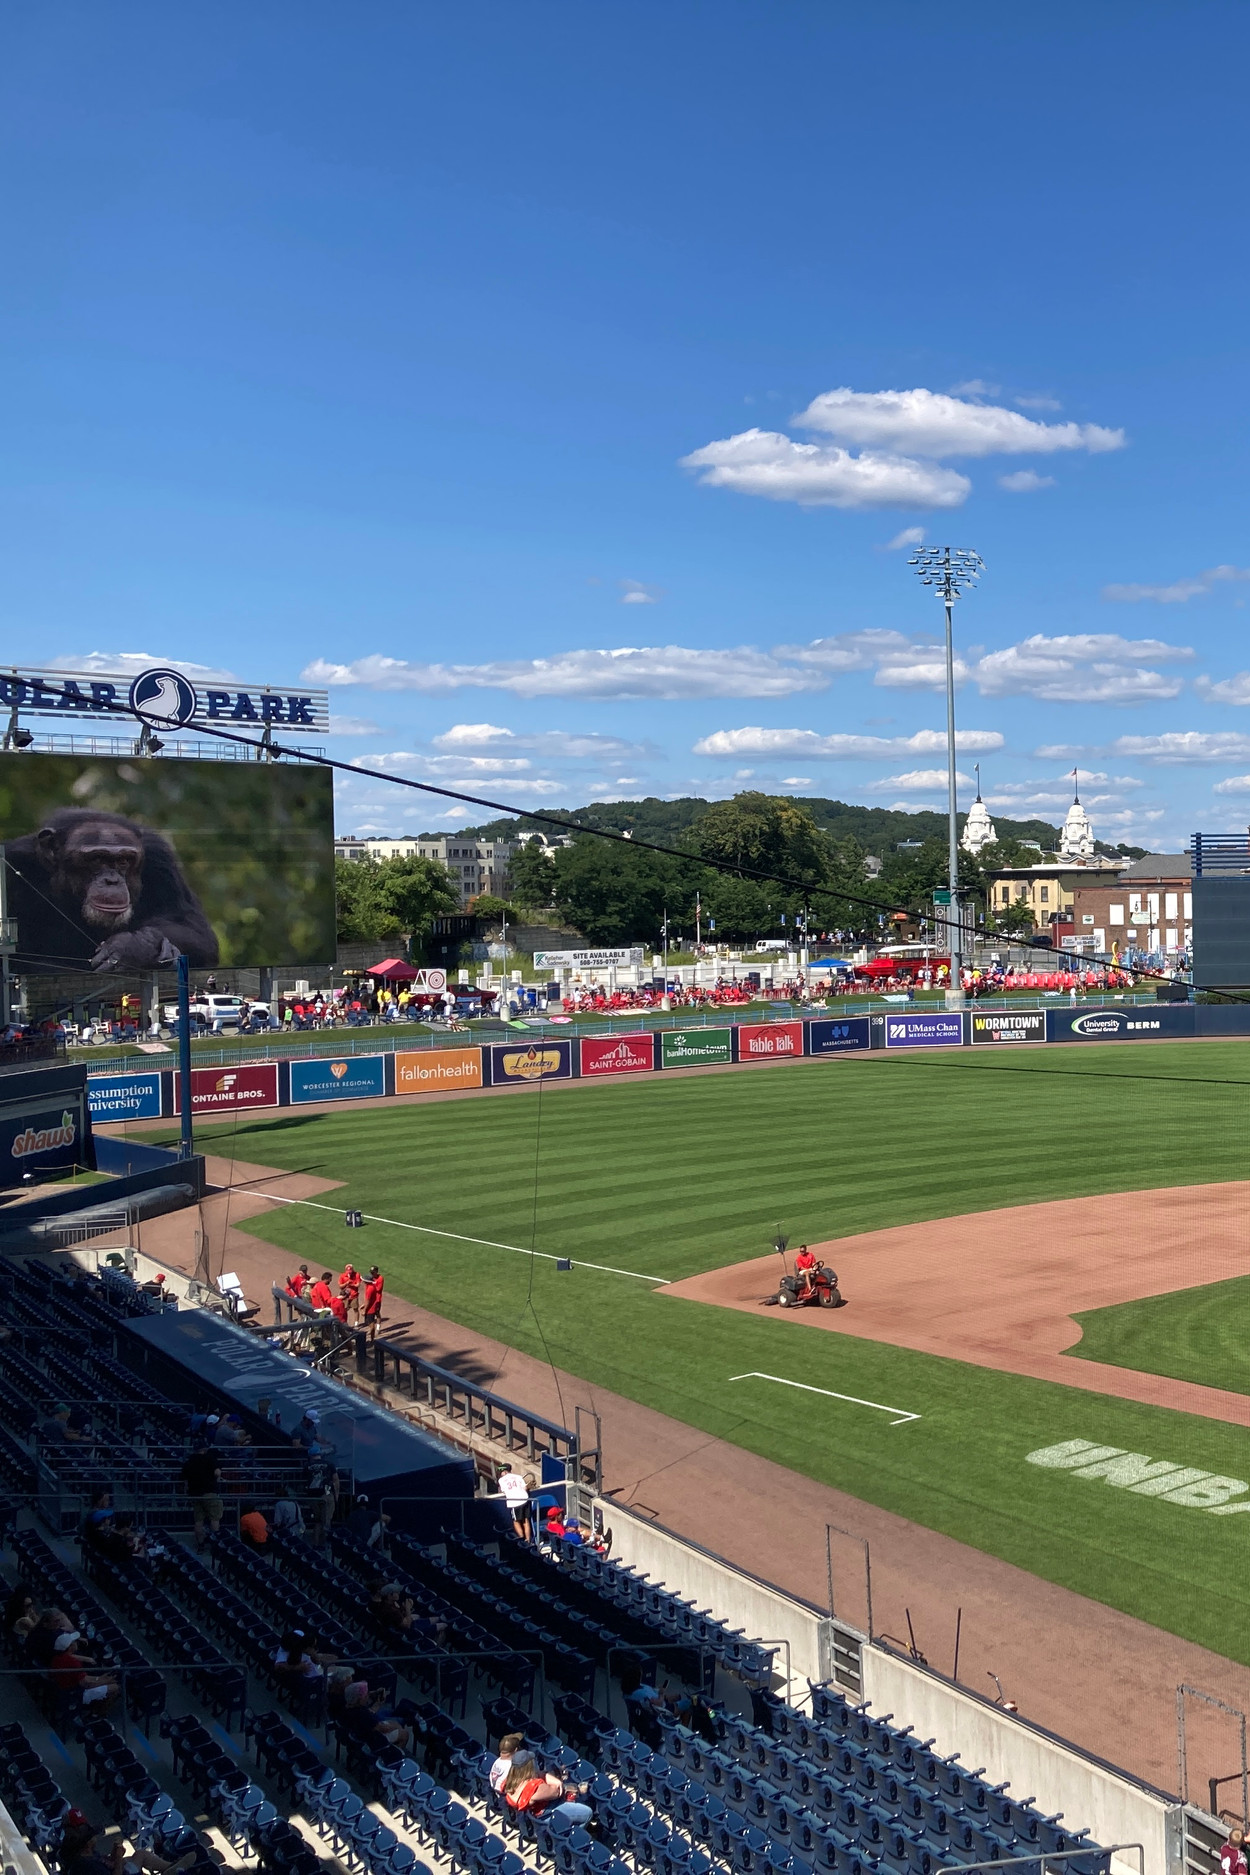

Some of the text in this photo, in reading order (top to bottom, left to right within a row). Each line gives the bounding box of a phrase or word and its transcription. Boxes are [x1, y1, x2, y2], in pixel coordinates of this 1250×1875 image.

[206, 691, 314, 723] PARK
[573, 951, 625, 960] SITE AVAILABLE
[908, 1022, 958, 1032] UMass Chan
[976, 1017, 1039, 1030] WORMTOWN
[1083, 1020, 1120, 1029] University
[1127, 1021, 1160, 1029] BERM
[749, 1034, 794, 1052] Table Talk
[822, 1038, 859, 1047] MASSACHUSETTS
[510, 1055, 554, 1069] Landry
[589, 1057, 647, 1069] SAINT-GOBAIN
[400, 1061, 478, 1081] fallonhealth
[303, 1079, 375, 1090] WORCESTER REGIONAL
[89, 1085, 153, 1100] ssumption
[191, 1089, 266, 1104] ONTAINE BROS.
[88, 1098, 142, 1112] niversity
[202, 1338, 275, 1372] POLAR
[506, 1480, 518, 1490] 34
